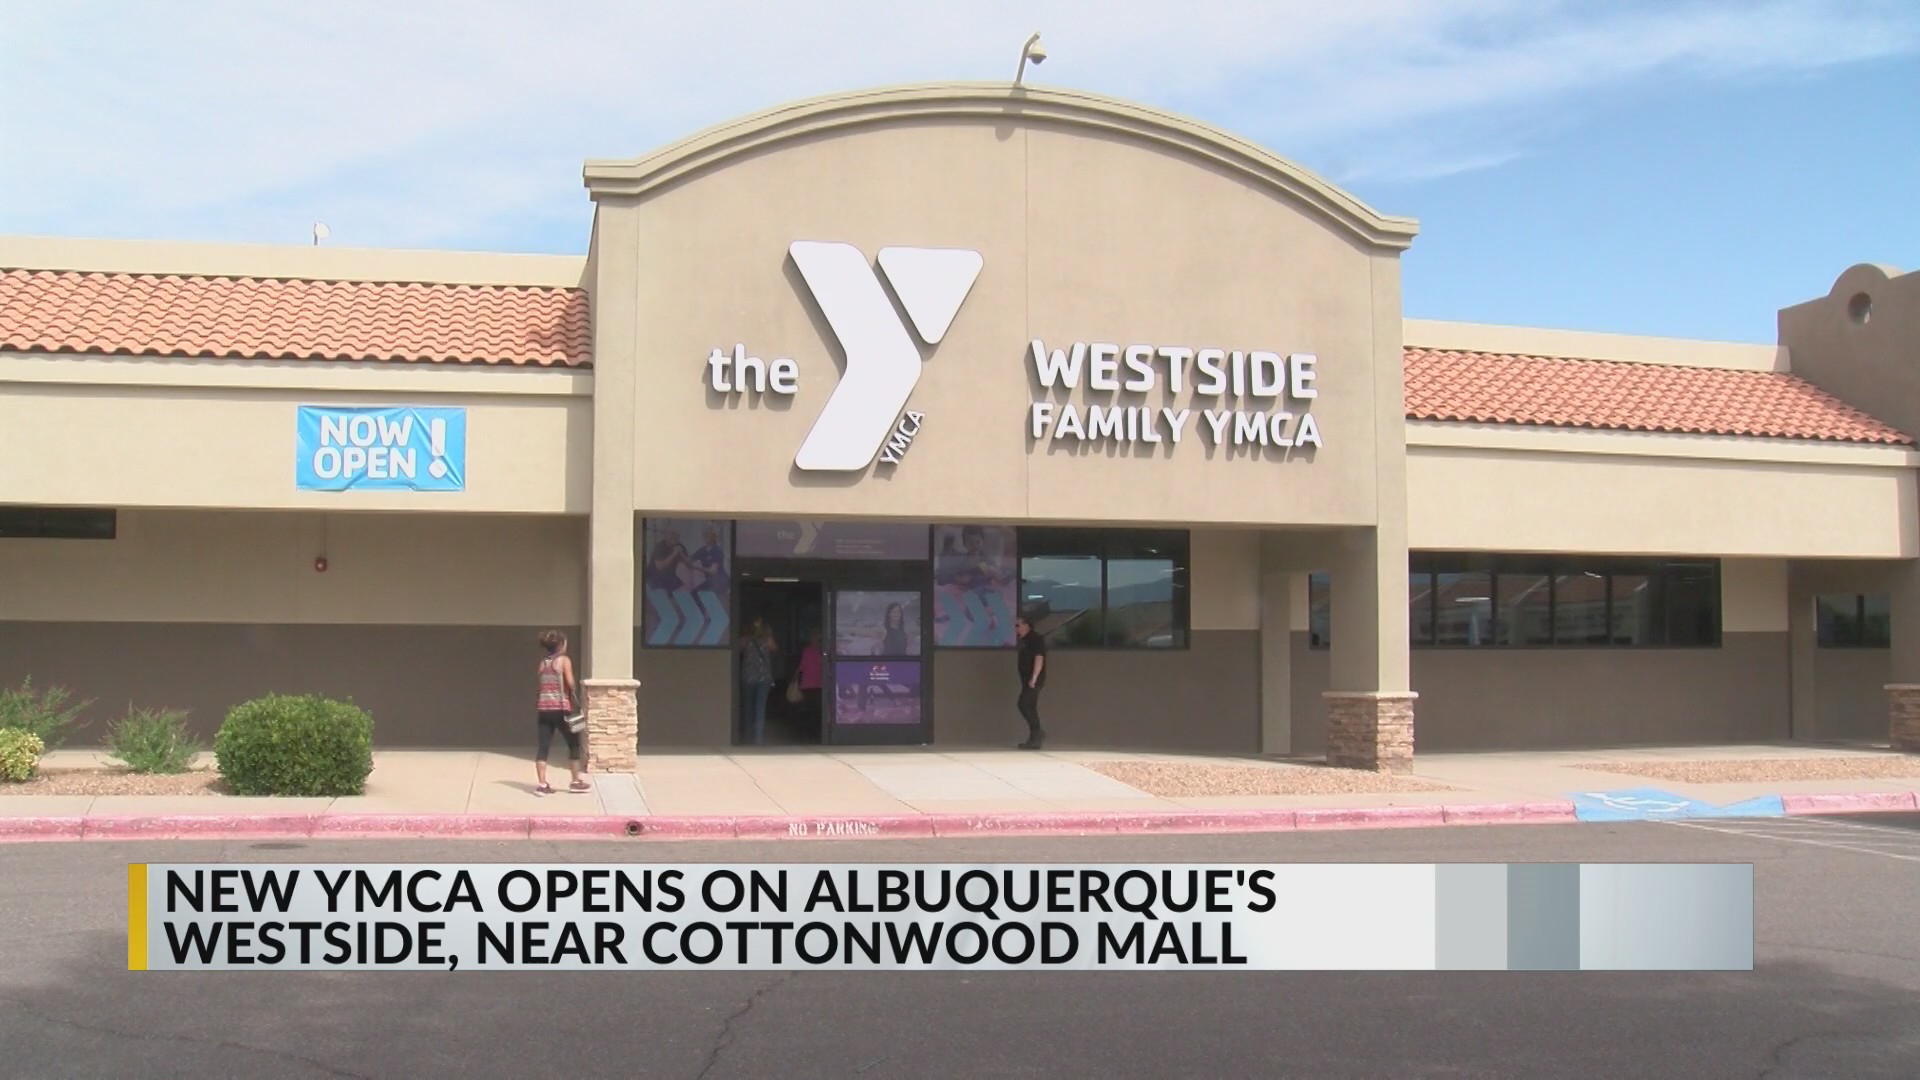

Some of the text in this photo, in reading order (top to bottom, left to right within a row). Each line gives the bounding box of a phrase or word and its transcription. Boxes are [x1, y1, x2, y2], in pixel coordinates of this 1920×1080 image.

[708, 240, 984, 471] the Y
[1030, 339, 1319, 399] WESTSIDE
[320, 415, 413, 447] NOW
[879, 410, 926, 465] YMCA
[1031, 402, 1323, 449] FAMILY YMCA
[313, 447, 417, 479] OPEN
[788, 821, 880, 836] NO PARKING
